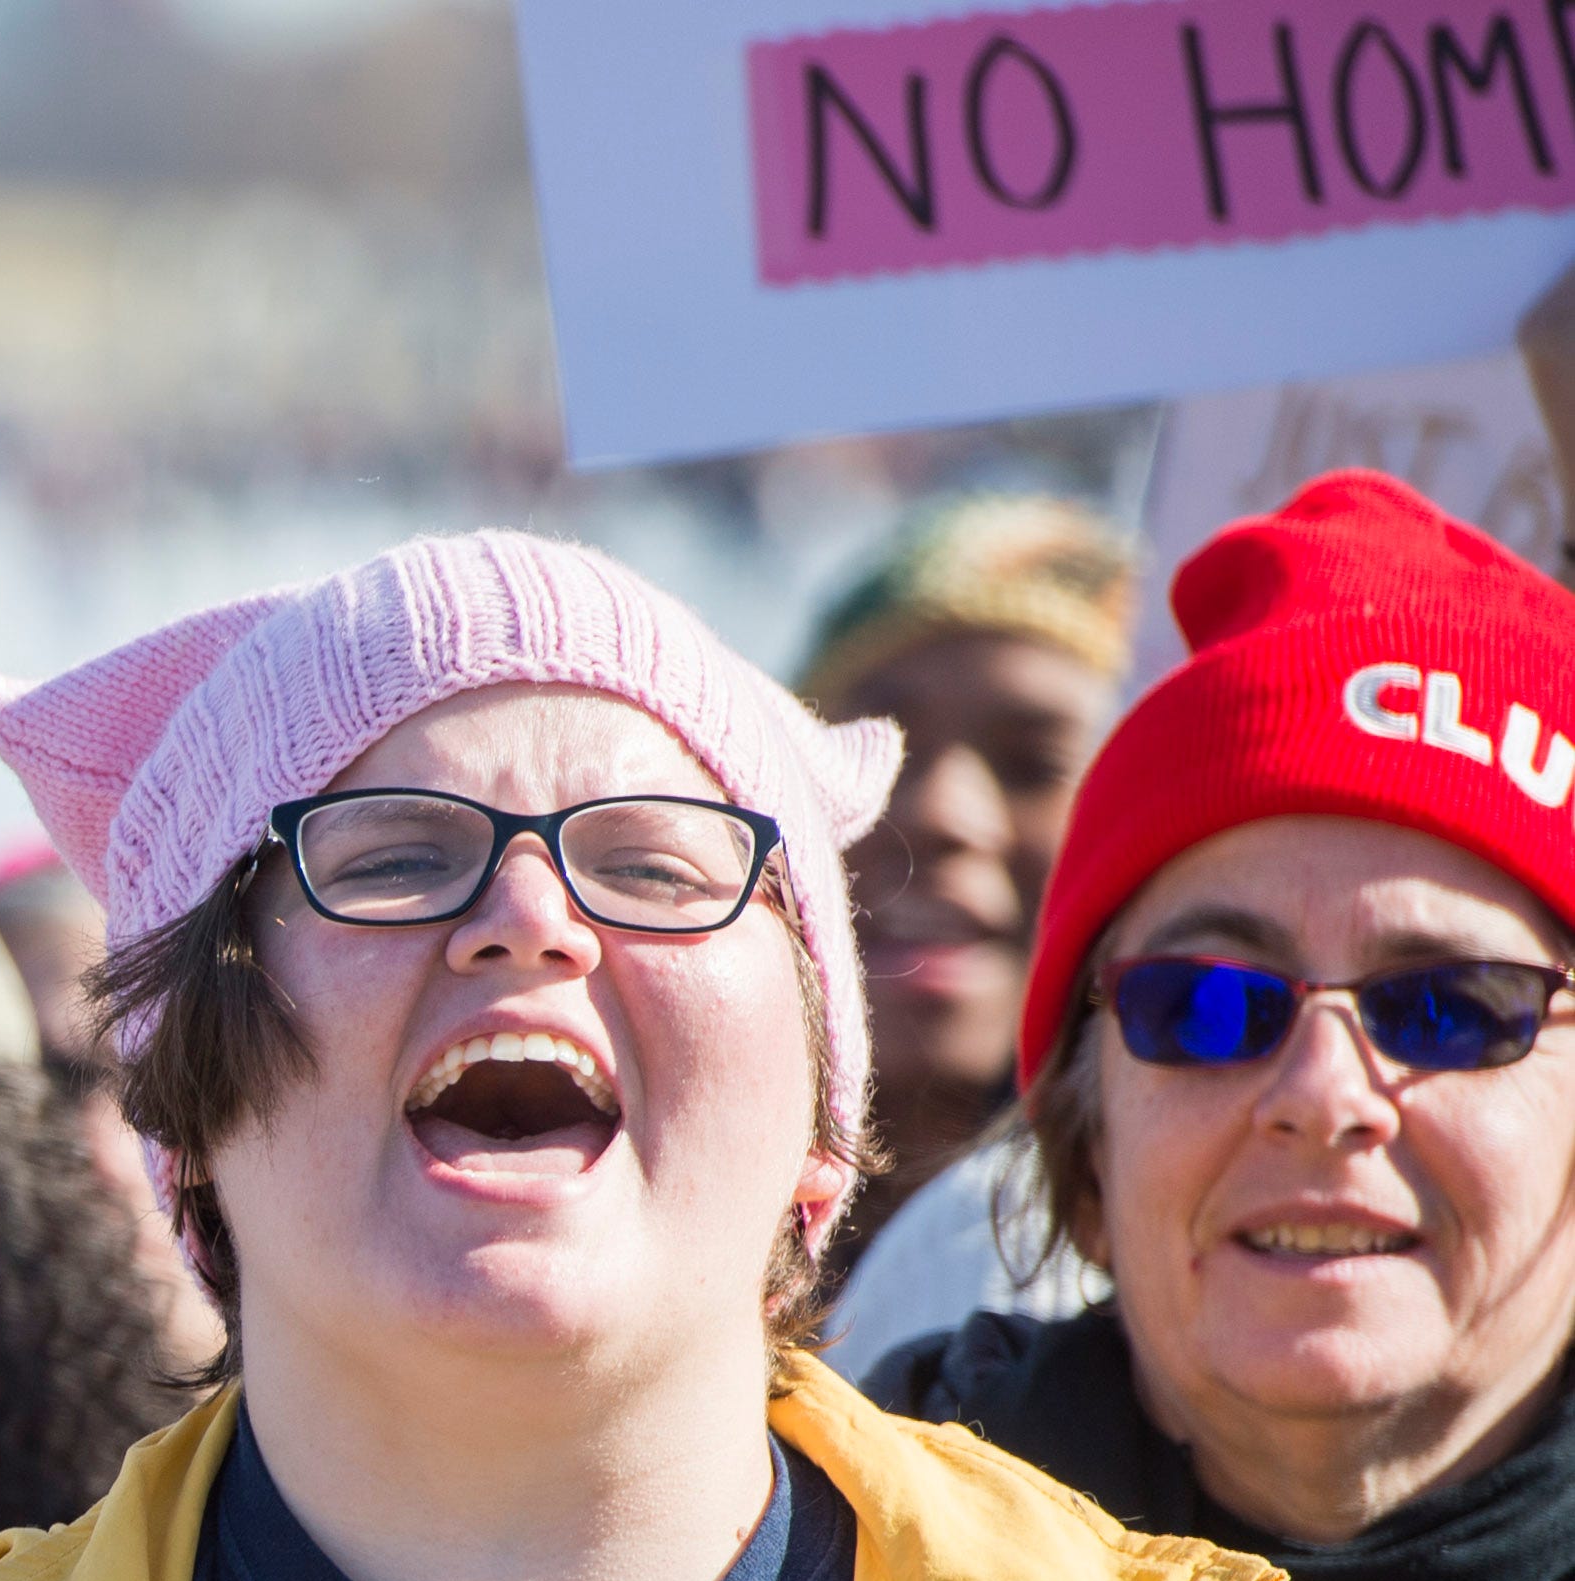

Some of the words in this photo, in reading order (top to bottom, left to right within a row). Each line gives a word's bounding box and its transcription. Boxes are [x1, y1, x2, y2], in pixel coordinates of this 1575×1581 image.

[801, 35, 1079, 240] NO
[1181, 0, 1575, 223] HOM
[1342, 660, 1575, 809] CLU
